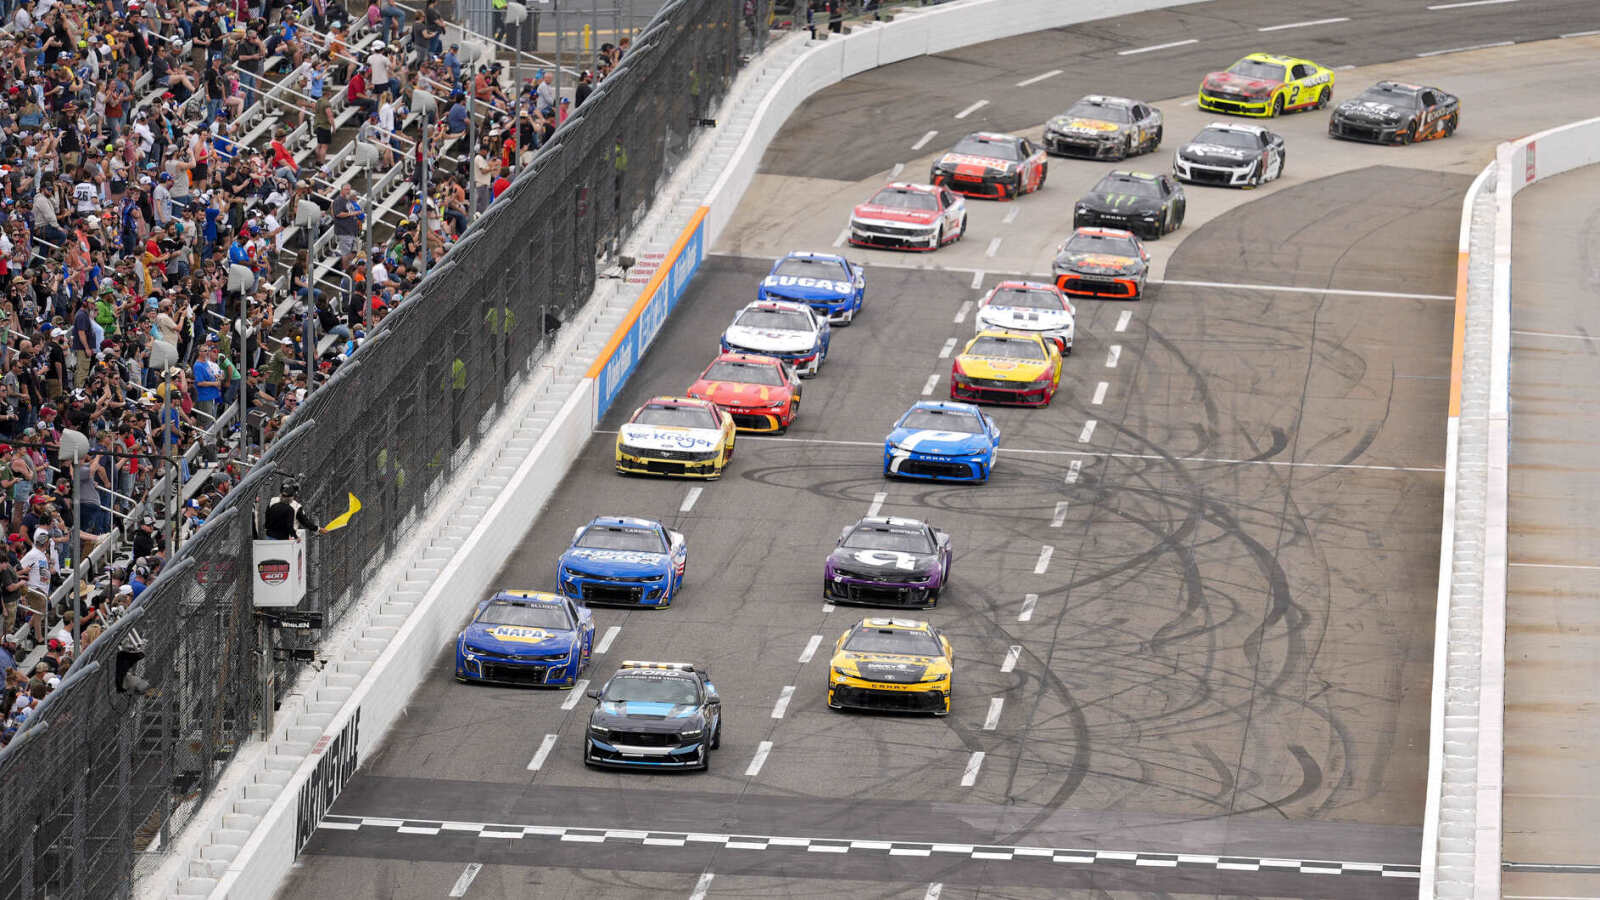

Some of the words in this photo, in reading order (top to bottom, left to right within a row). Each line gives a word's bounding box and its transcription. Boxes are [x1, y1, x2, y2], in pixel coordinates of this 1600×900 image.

[1287, 86, 1300, 104] 2
[77, 190, 89, 201] 26
[764, 275, 851, 295] LUCAS
[653, 431, 714, 449] Kroger
[497, 626, 544, 639] NAPA
[293, 704, 361, 864] MARTINSVILLE
